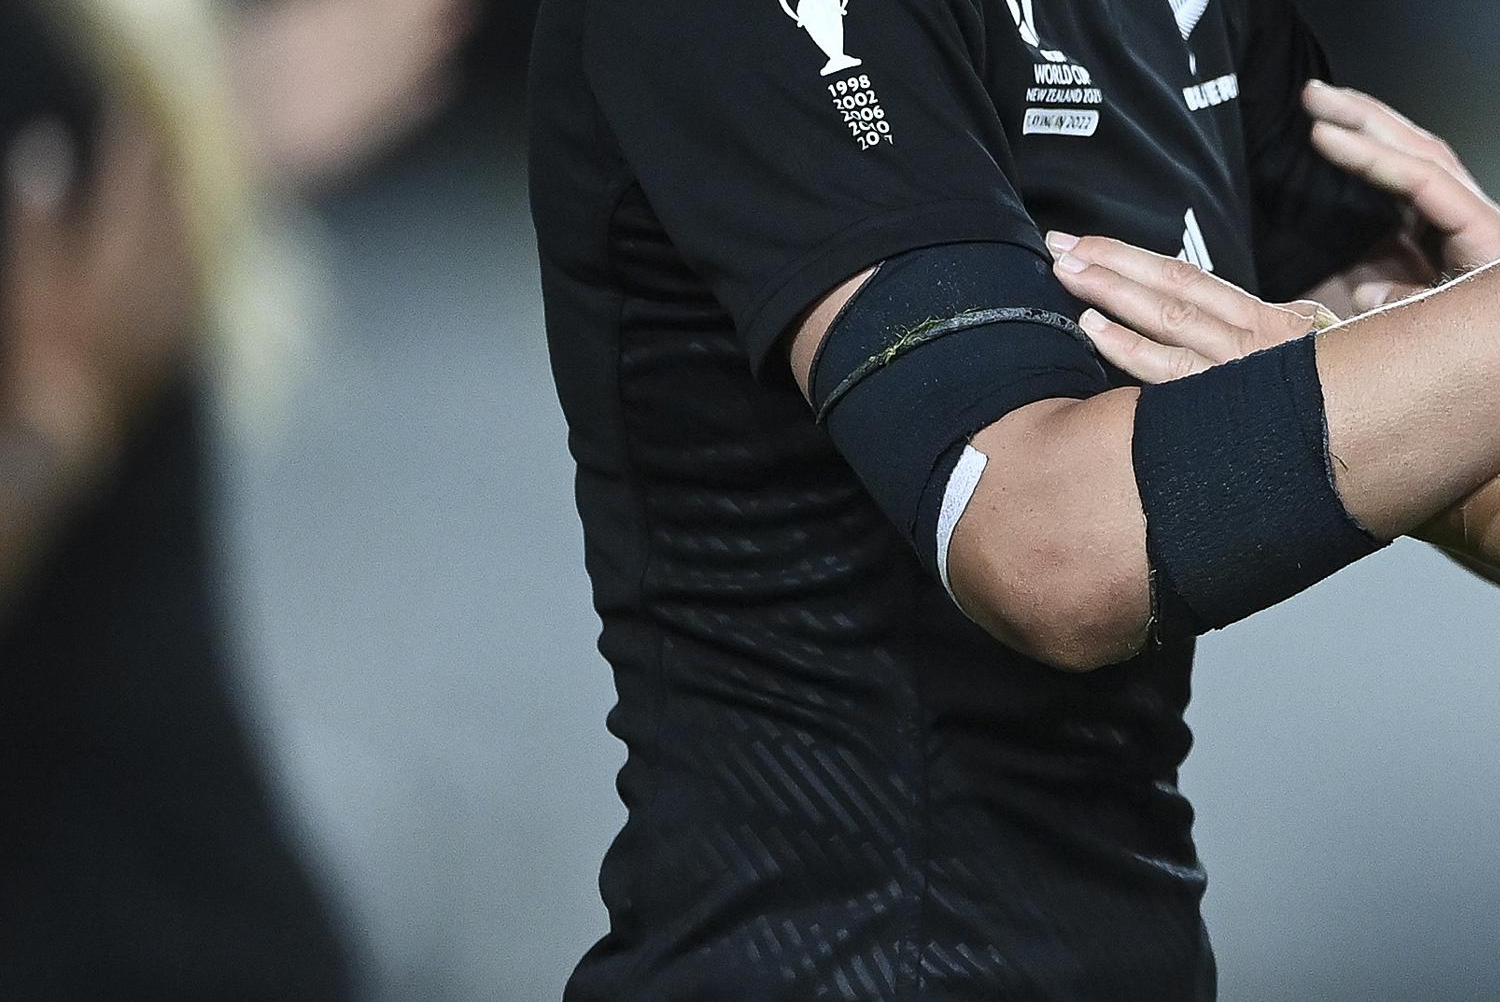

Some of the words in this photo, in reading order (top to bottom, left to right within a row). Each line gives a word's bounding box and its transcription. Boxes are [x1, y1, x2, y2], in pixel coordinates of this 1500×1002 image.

[1034, 63, 1073, 85] WORLD
[828, 74, 871, 97] 1998
[1026, 87, 1047, 102] NEW
[833, 90, 878, 109] 2002
[840, 105, 885, 122] 2006
[848, 120, 890, 137] 2010
[1065, 116, 1092, 130] 2022
[856, 131, 893, 150] 207
